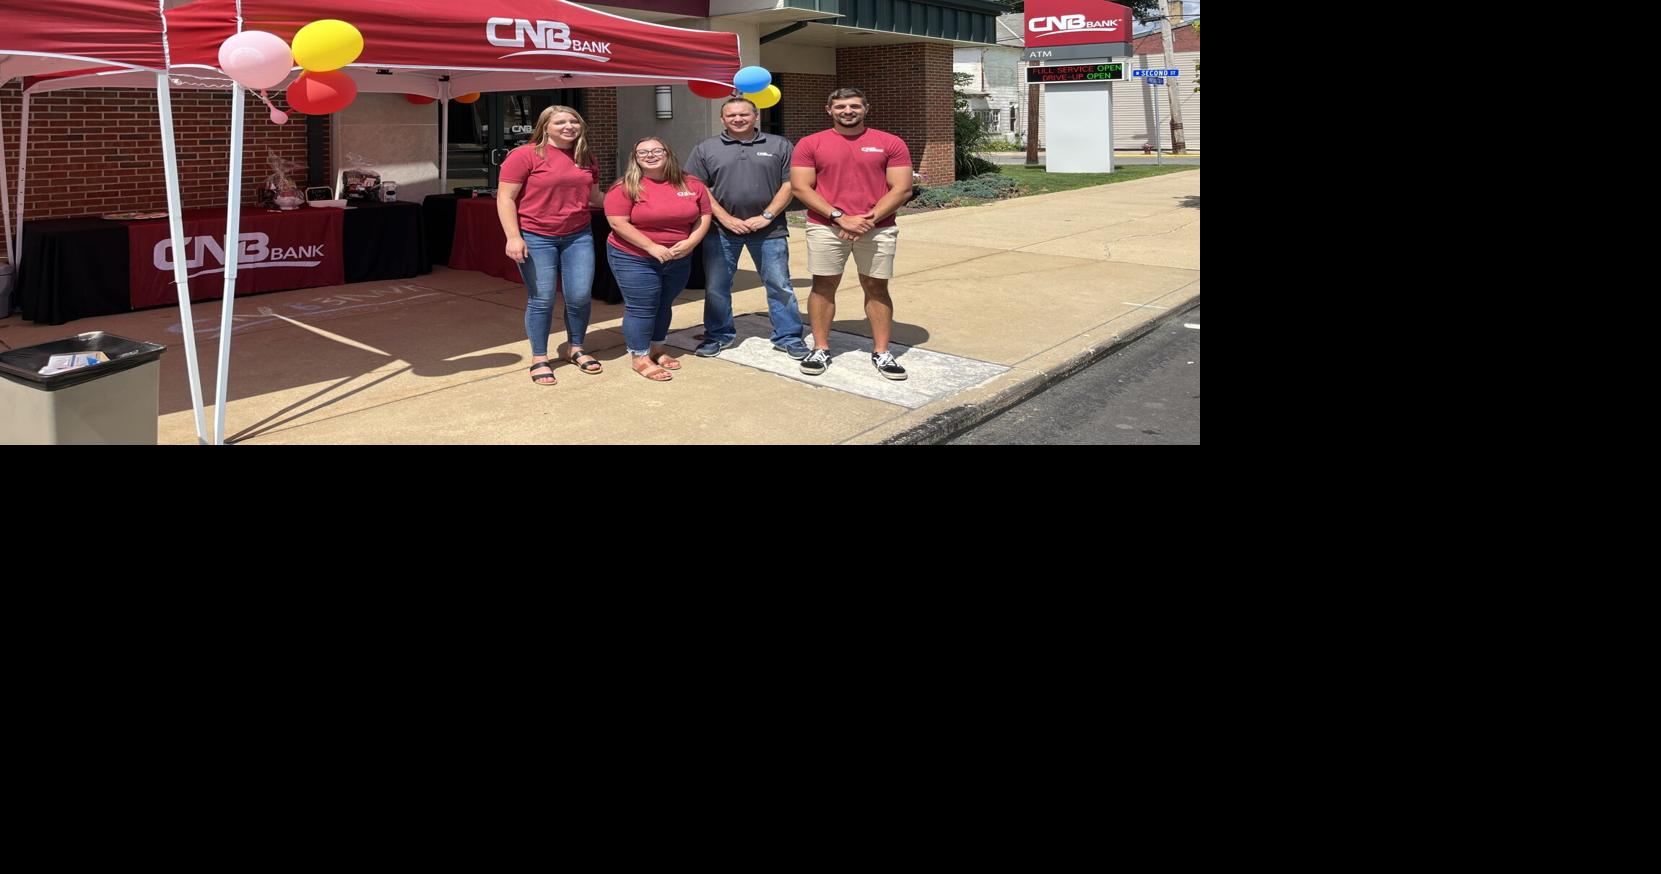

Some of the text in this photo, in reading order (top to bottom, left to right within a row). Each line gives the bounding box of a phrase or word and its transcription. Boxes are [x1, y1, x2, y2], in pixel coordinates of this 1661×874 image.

[1028, 14, 1118, 32] CNB BANK
[486, 16, 612, 54] CNB BANK
[1042, 72, 1111, 81] DRIVE-UP OPEN
[1057, 65, 1094, 73] SERVICE
[1097, 64, 1121, 72] OPEN
[270, 244, 324, 261] BANK
